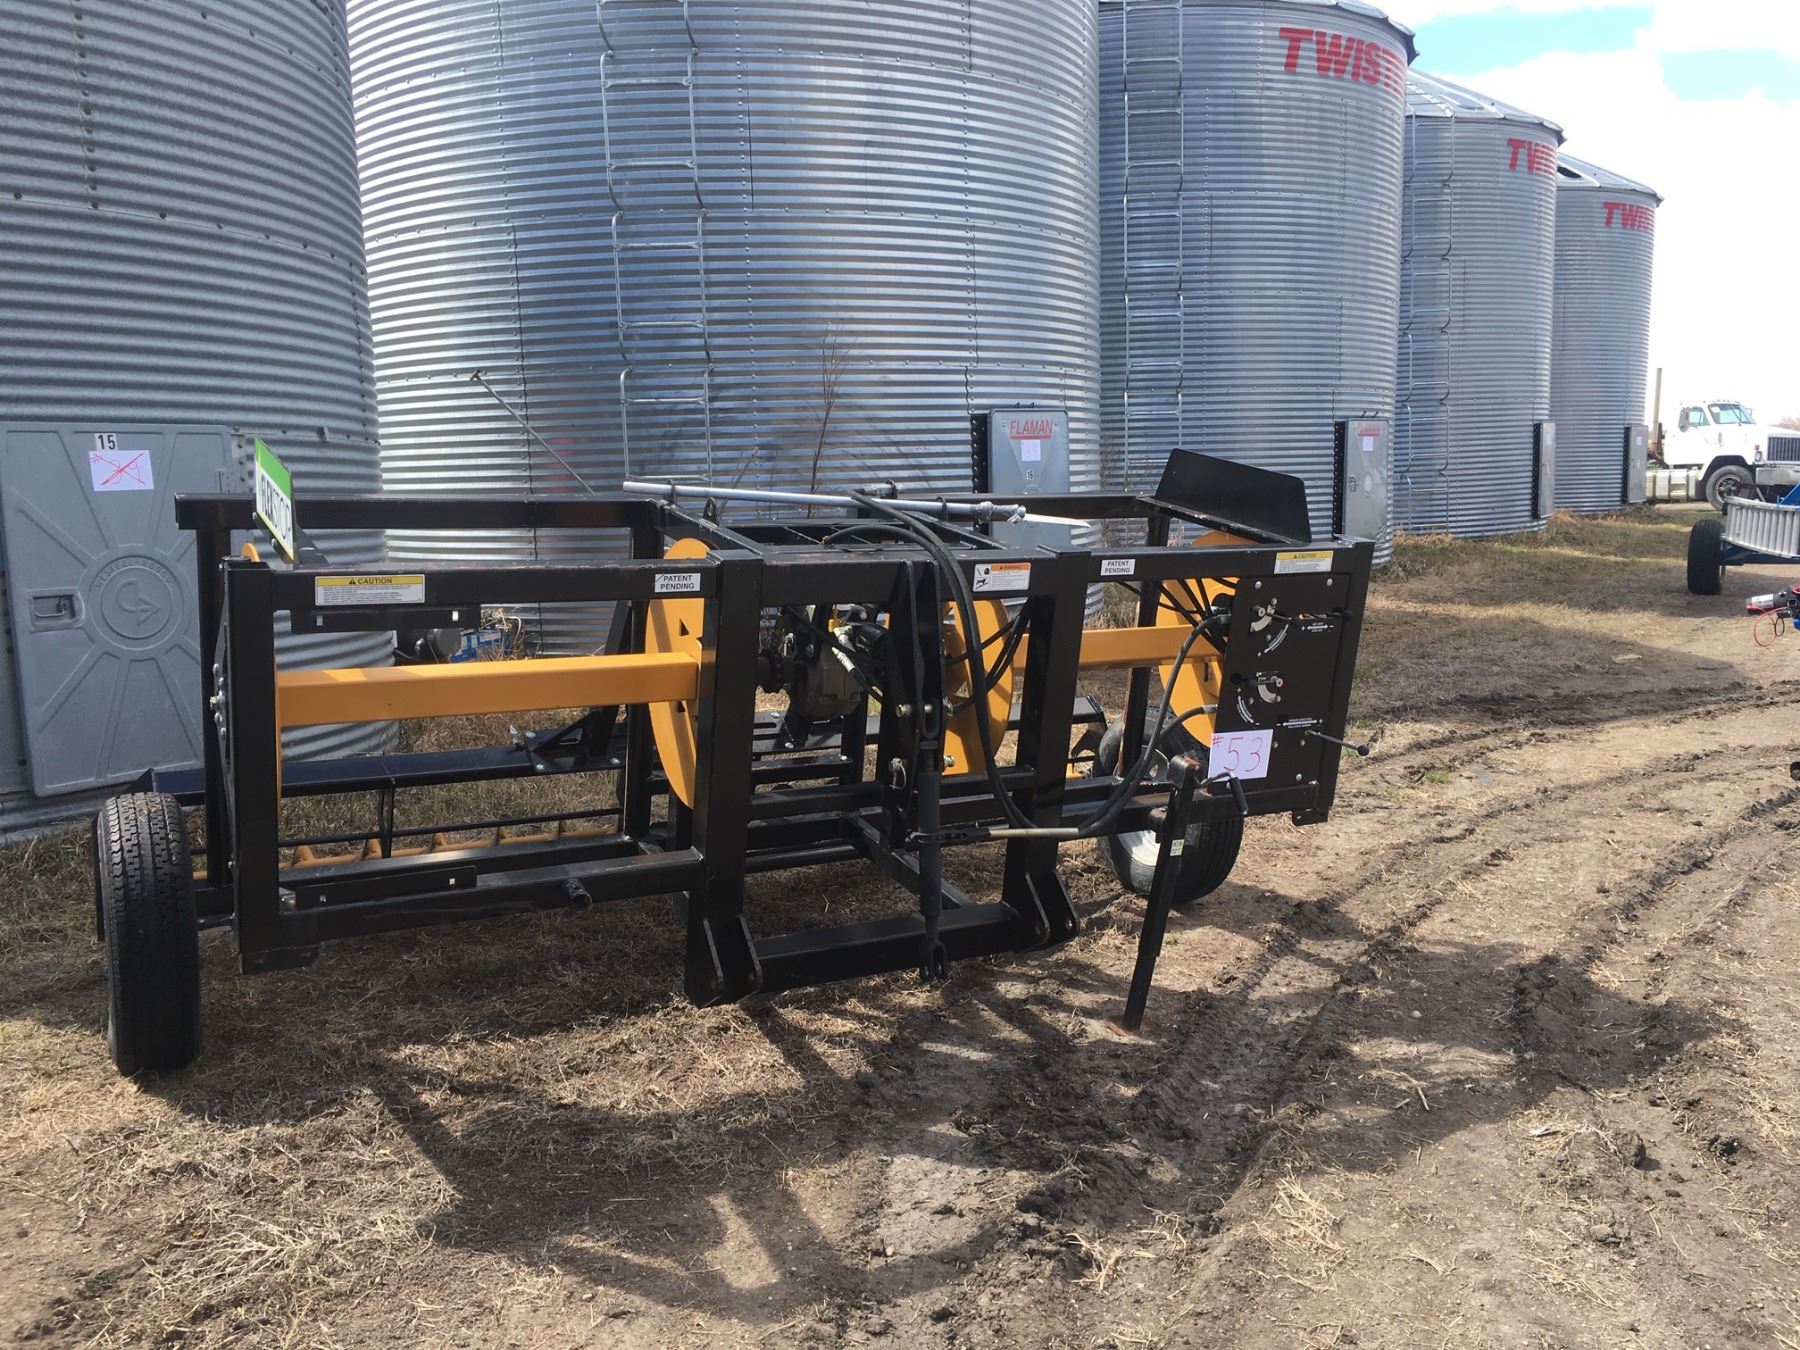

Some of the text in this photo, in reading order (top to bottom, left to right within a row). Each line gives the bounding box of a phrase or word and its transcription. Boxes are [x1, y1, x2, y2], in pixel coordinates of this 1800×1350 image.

[1009, 419, 1053, 436] FLAMAN
[98, 434, 116, 450] 15
[357, 577, 393, 585] CAUTION
[660, 582, 695, 590] PENDING
